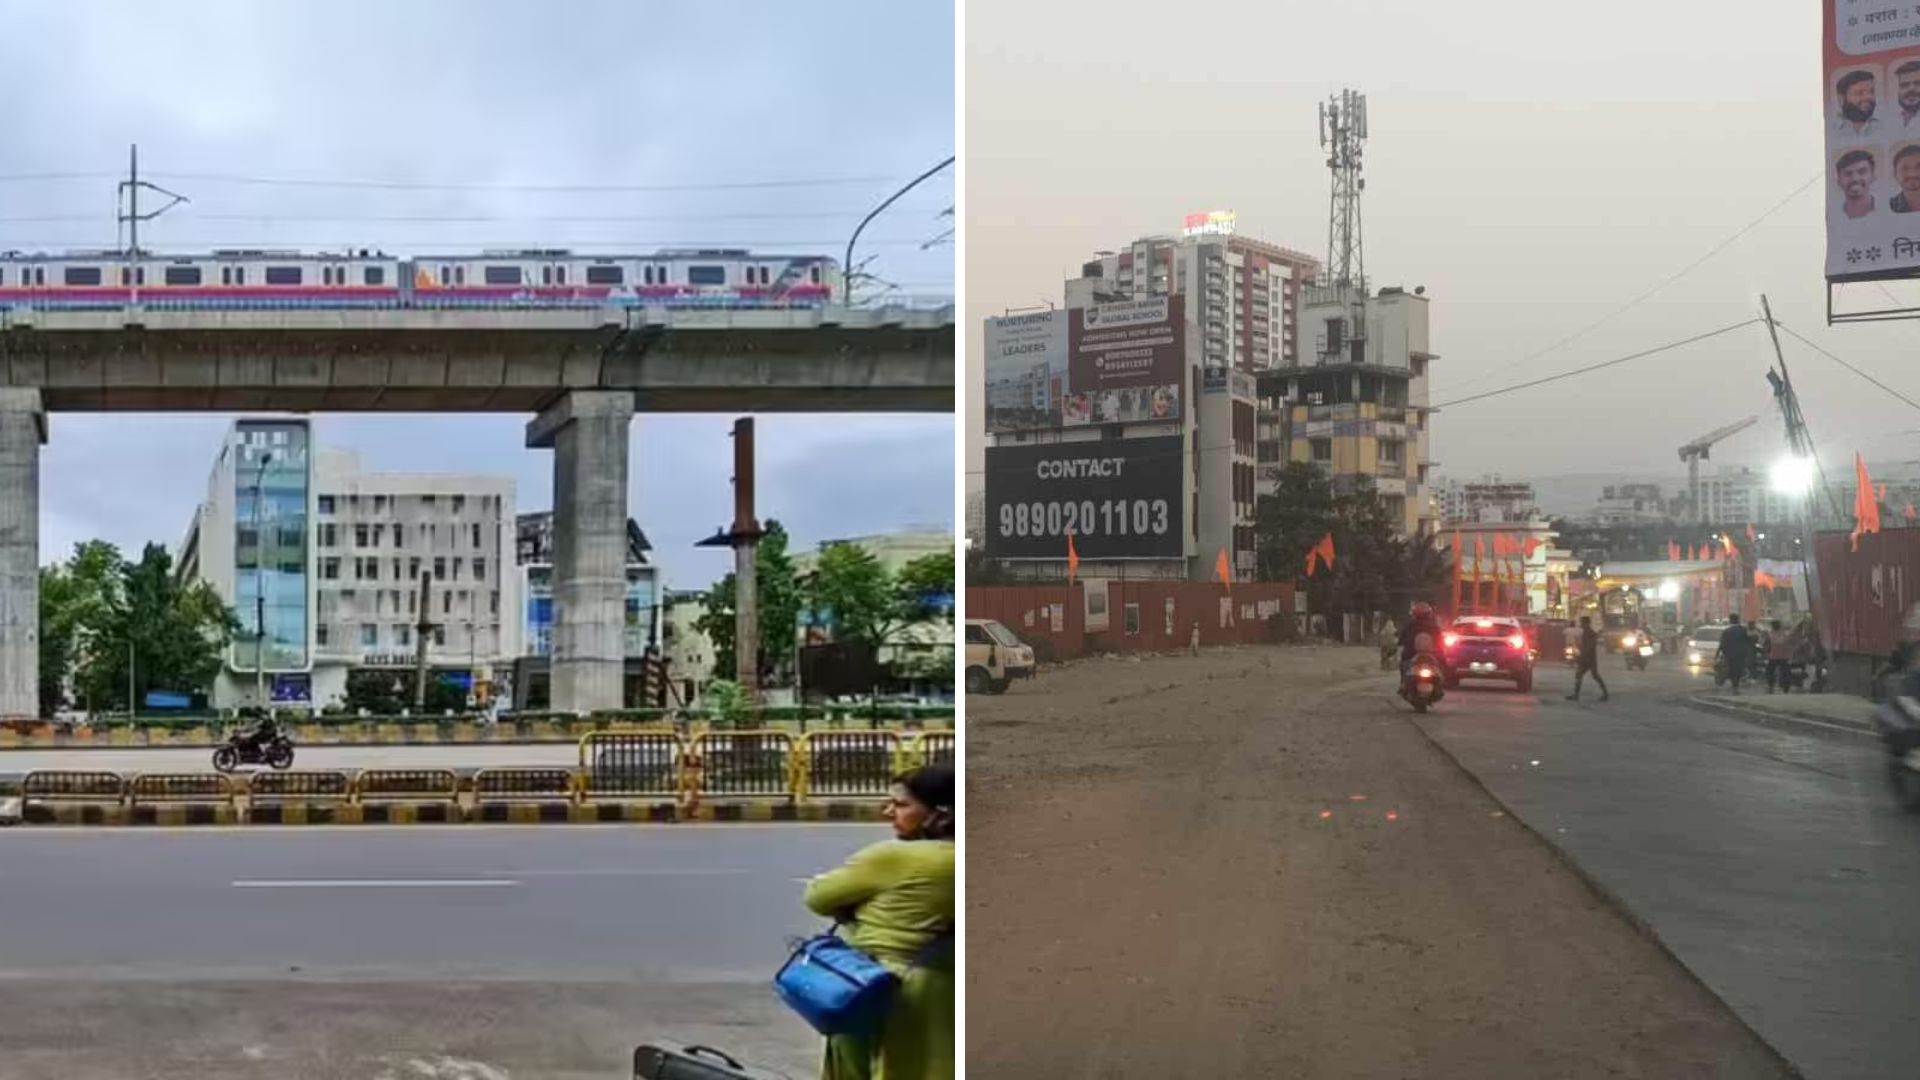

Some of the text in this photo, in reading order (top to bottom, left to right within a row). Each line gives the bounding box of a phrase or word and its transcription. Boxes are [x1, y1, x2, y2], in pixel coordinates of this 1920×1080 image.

[1892, 237, 1920, 260] नि
[997, 311, 1052, 327] NURTURING
[1149, 327, 1172, 336] OPEN
[1002, 342, 1048, 356] LEADERS
[1037, 458, 1126, 479] CONTACT
